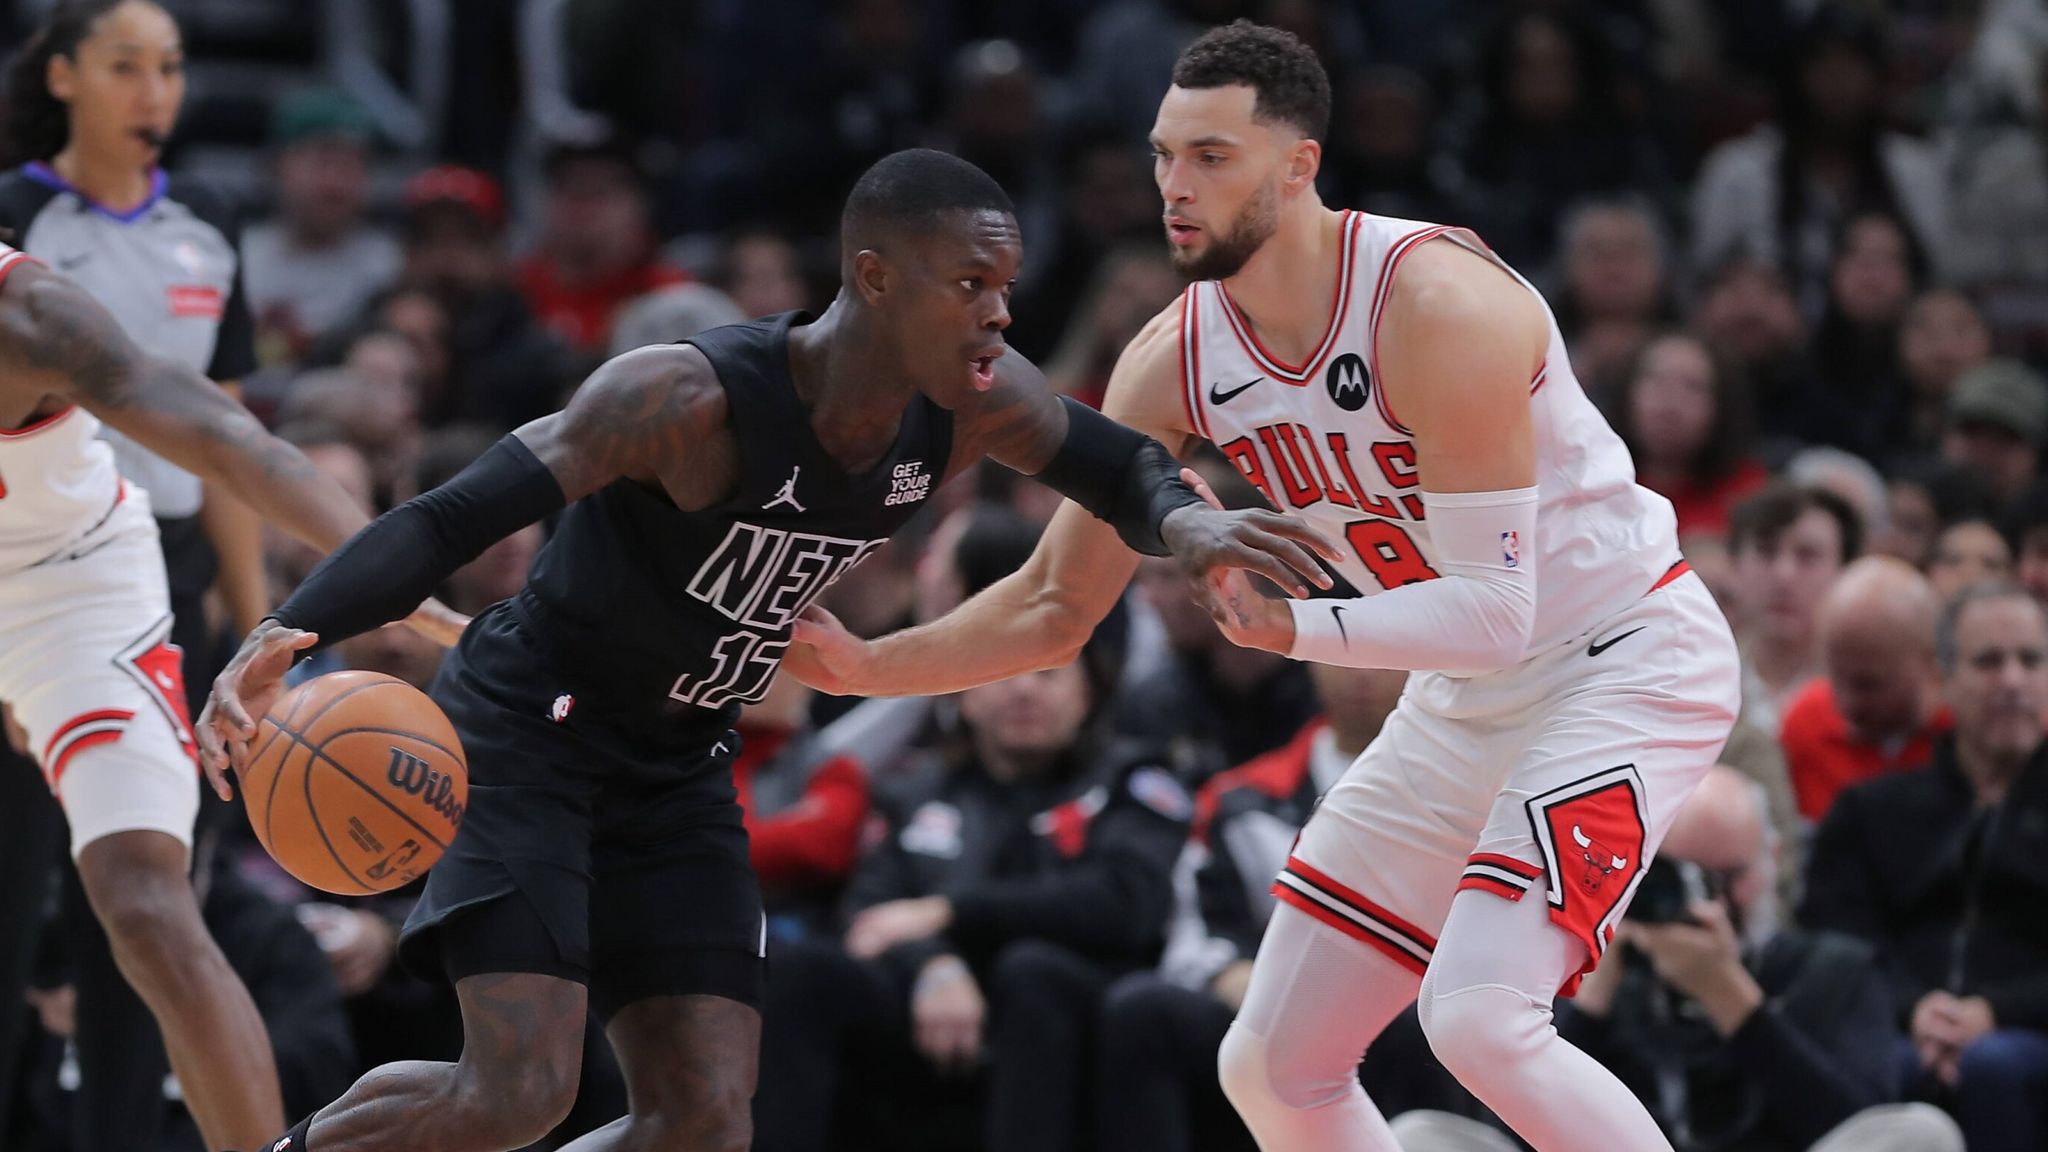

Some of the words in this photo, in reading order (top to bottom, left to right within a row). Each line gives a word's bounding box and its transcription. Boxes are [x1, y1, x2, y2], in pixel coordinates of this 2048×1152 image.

[884, 487, 929, 506] GUIDE
[892, 473, 931, 492] YOUR
[893, 461, 923, 478] GET
[1220, 422, 1426, 521] BULLS
[685, 520, 890, 631] NET
[668, 630, 791, 710] 17
[387, 745, 464, 827] Wilso
